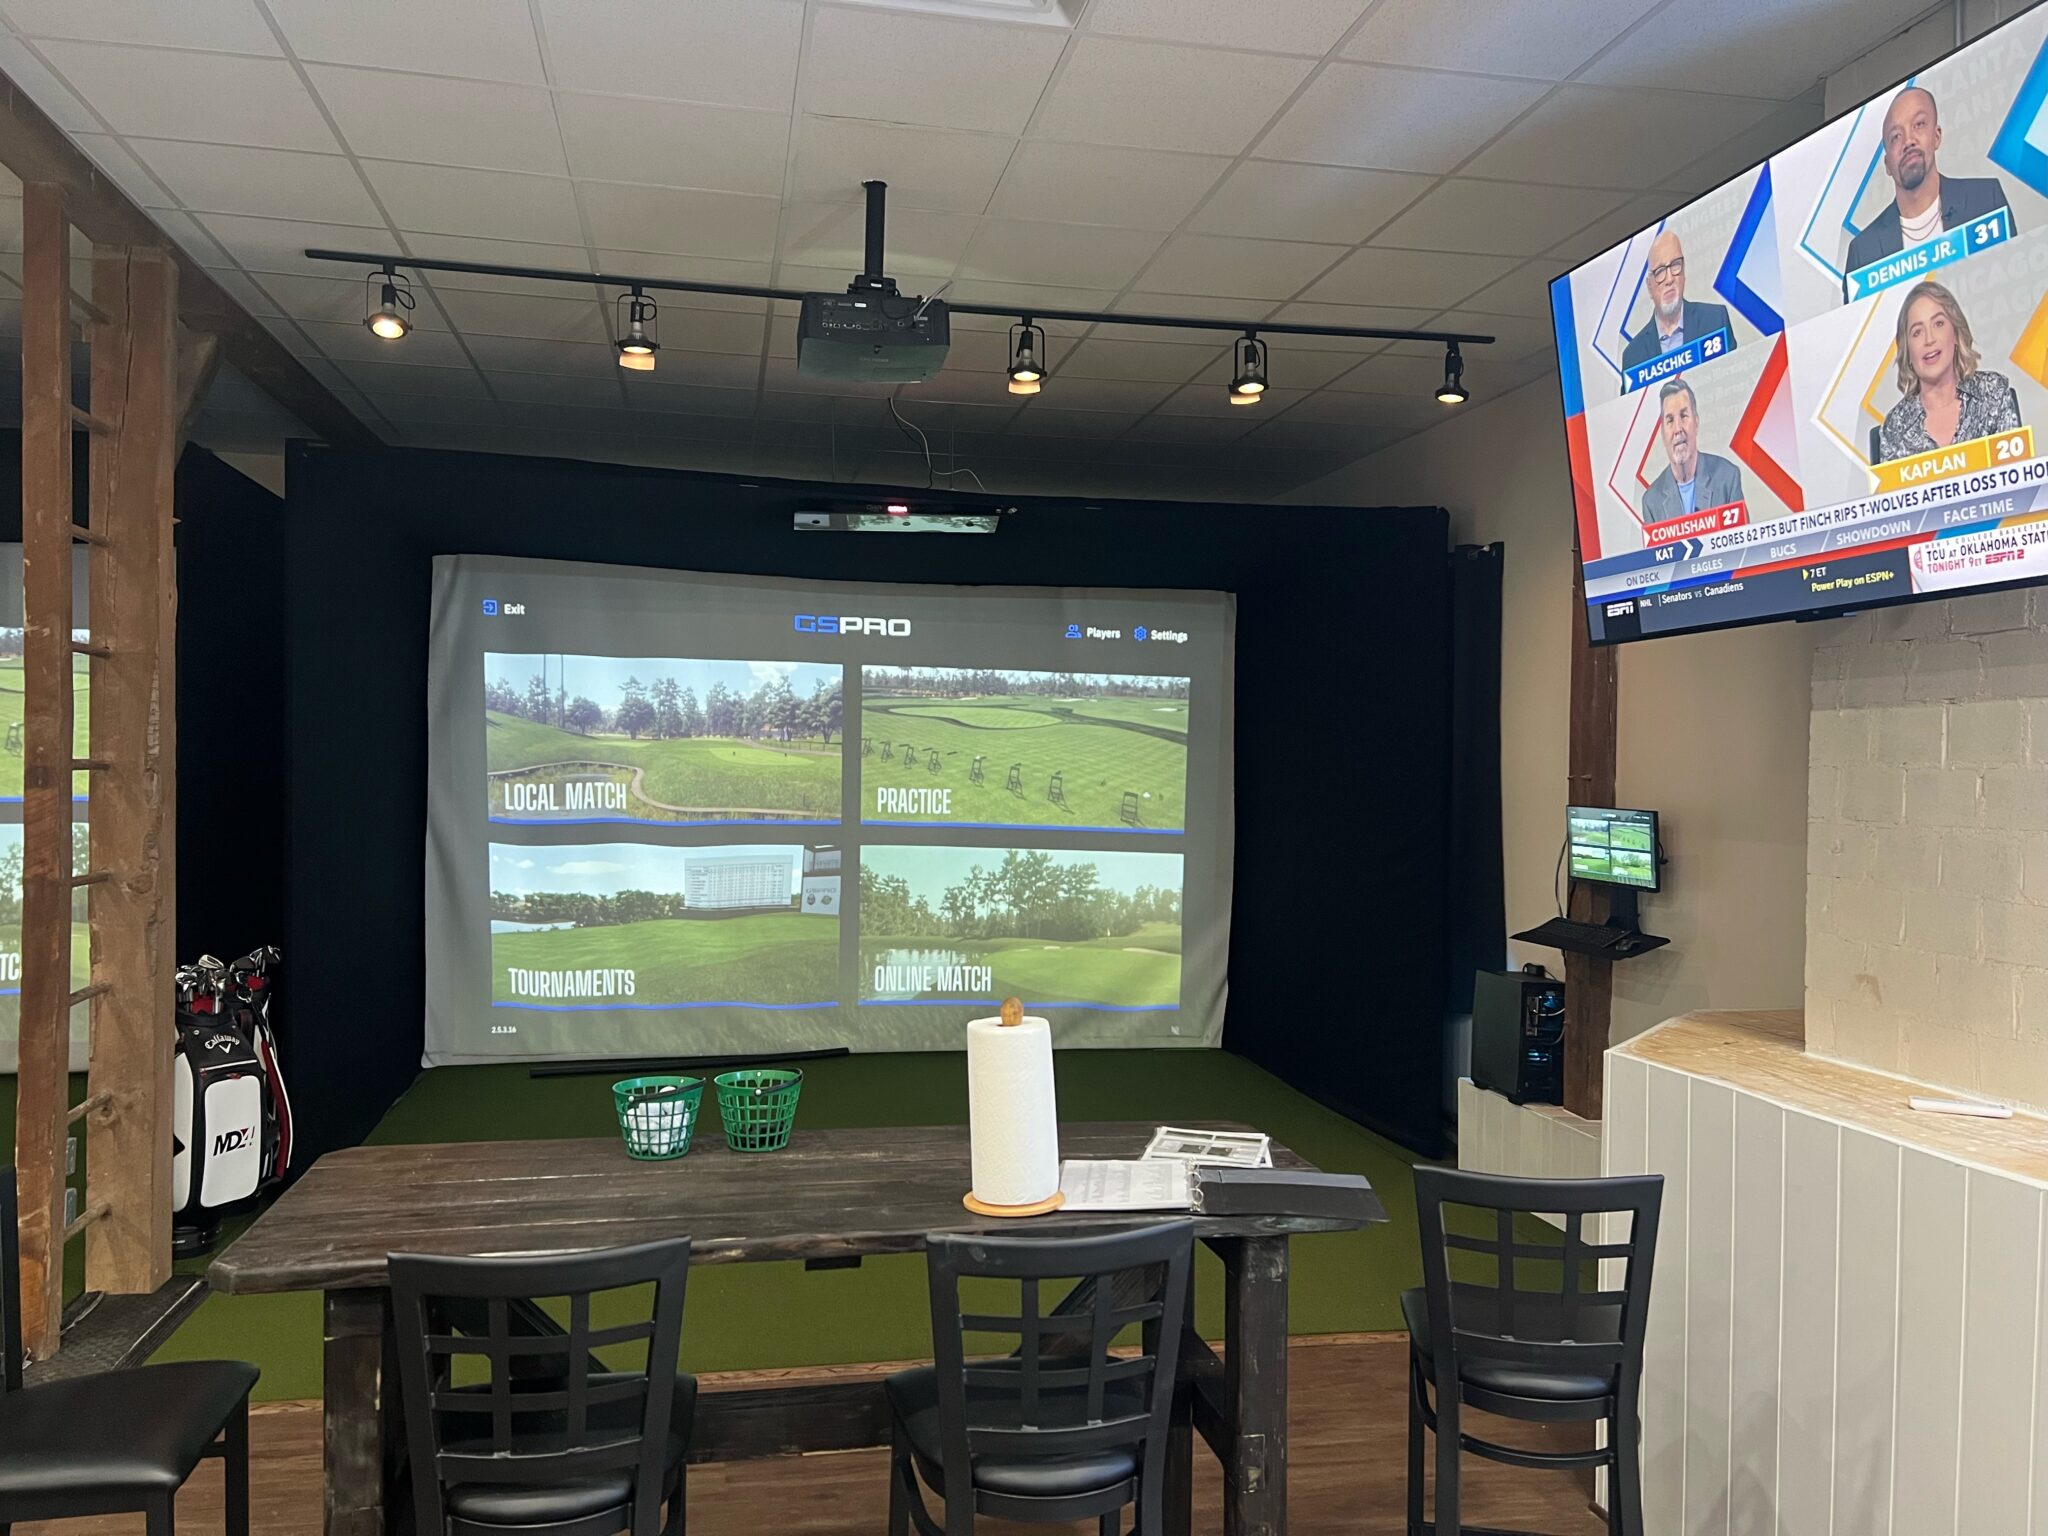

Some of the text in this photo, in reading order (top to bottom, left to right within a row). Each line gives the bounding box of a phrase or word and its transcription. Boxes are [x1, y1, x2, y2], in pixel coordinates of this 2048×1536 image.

[1974, 218, 2000, 245] 31
[1867, 240, 1956, 289] DENNIS JR.
[1703, 336, 1722, 357] 28
[1638, 349, 1693, 384] PLASCHKE
[1995, 436, 2025, 460] 20
[1899, 452, 1967, 483] KAPLAN
[1711, 461, 2048, 550] SCORES 62 PTS BUT FINCH RIPS T-WOLVES AFTER LOSS TO HO
[1943, 498, 2014, 524] FACE TIME
[1651, 515, 1717, 542] COWLISHAW
[1722, 508, 1740, 527] 27
[1836, 520, 1911, 545] SHOWDOWN
[1655, 547, 1674, 562] KAT
[1770, 543, 1797, 558] BUCS
[1926, 548, 1946, 562] TCU
[1949, 549, 1957, 558] AT
[1960, 536, 2018, 556] OKLAHOMA
[1690, 559, 1723, 575] EAGLES
[1927, 558, 1965, 574] TONIGHT
[1626, 571, 1661, 587] ON DECK
[1811, 570, 1895, 592] Power Play on ESPN+
[1640, 599, 1653, 608] NHL
[1661, 582, 1744, 604] Senators vs Canadiens
[503, 603, 526, 616] Exit
[1606, 601, 1634, 617] ESPN
[793, 613, 912, 637] GSPRO
[1086, 626, 1121, 640] Players
[1150, 630, 1188, 643] Settings
[504, 780, 628, 811] LOCAL MATCH
[876, 786, 952, 815] PRACTICE
[507, 967, 636, 998] TOURNAMENTS
[874, 965, 992, 992] ONLINE MATCH
[204, 1033, 240, 1049] Callaway
